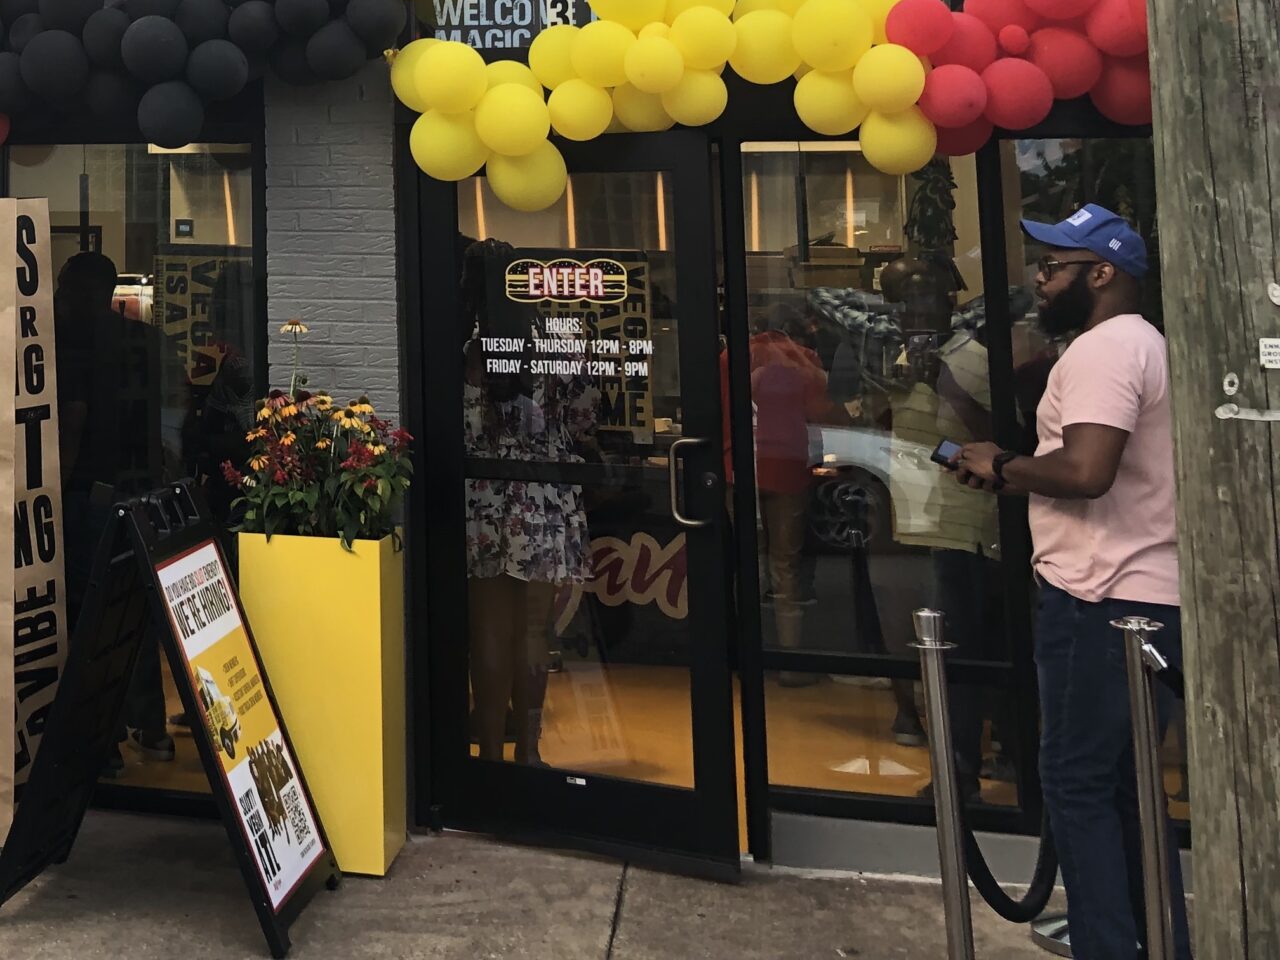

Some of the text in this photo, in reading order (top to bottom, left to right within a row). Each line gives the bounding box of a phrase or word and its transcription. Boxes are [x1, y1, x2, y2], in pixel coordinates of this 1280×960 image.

[527, 267, 605, 297] ENTER
[545, 317, 583, 333] HOURS:
[480, 337, 525, 352] TUESDAY
[533, 338, 587, 354] THURSDAY
[590, 339, 620, 355] 12PM
[629, 340, 653, 355] 8PM
[486, 359, 521, 374] FRIDAY
[530, 360, 583, 375] SATURDAY
[586, 361, 615, 376] 12PM
[624, 362, 649, 377] 9PM
[171, 576, 234, 641] WE'RE HIRING!
[255, 828, 282, 885] ATL
